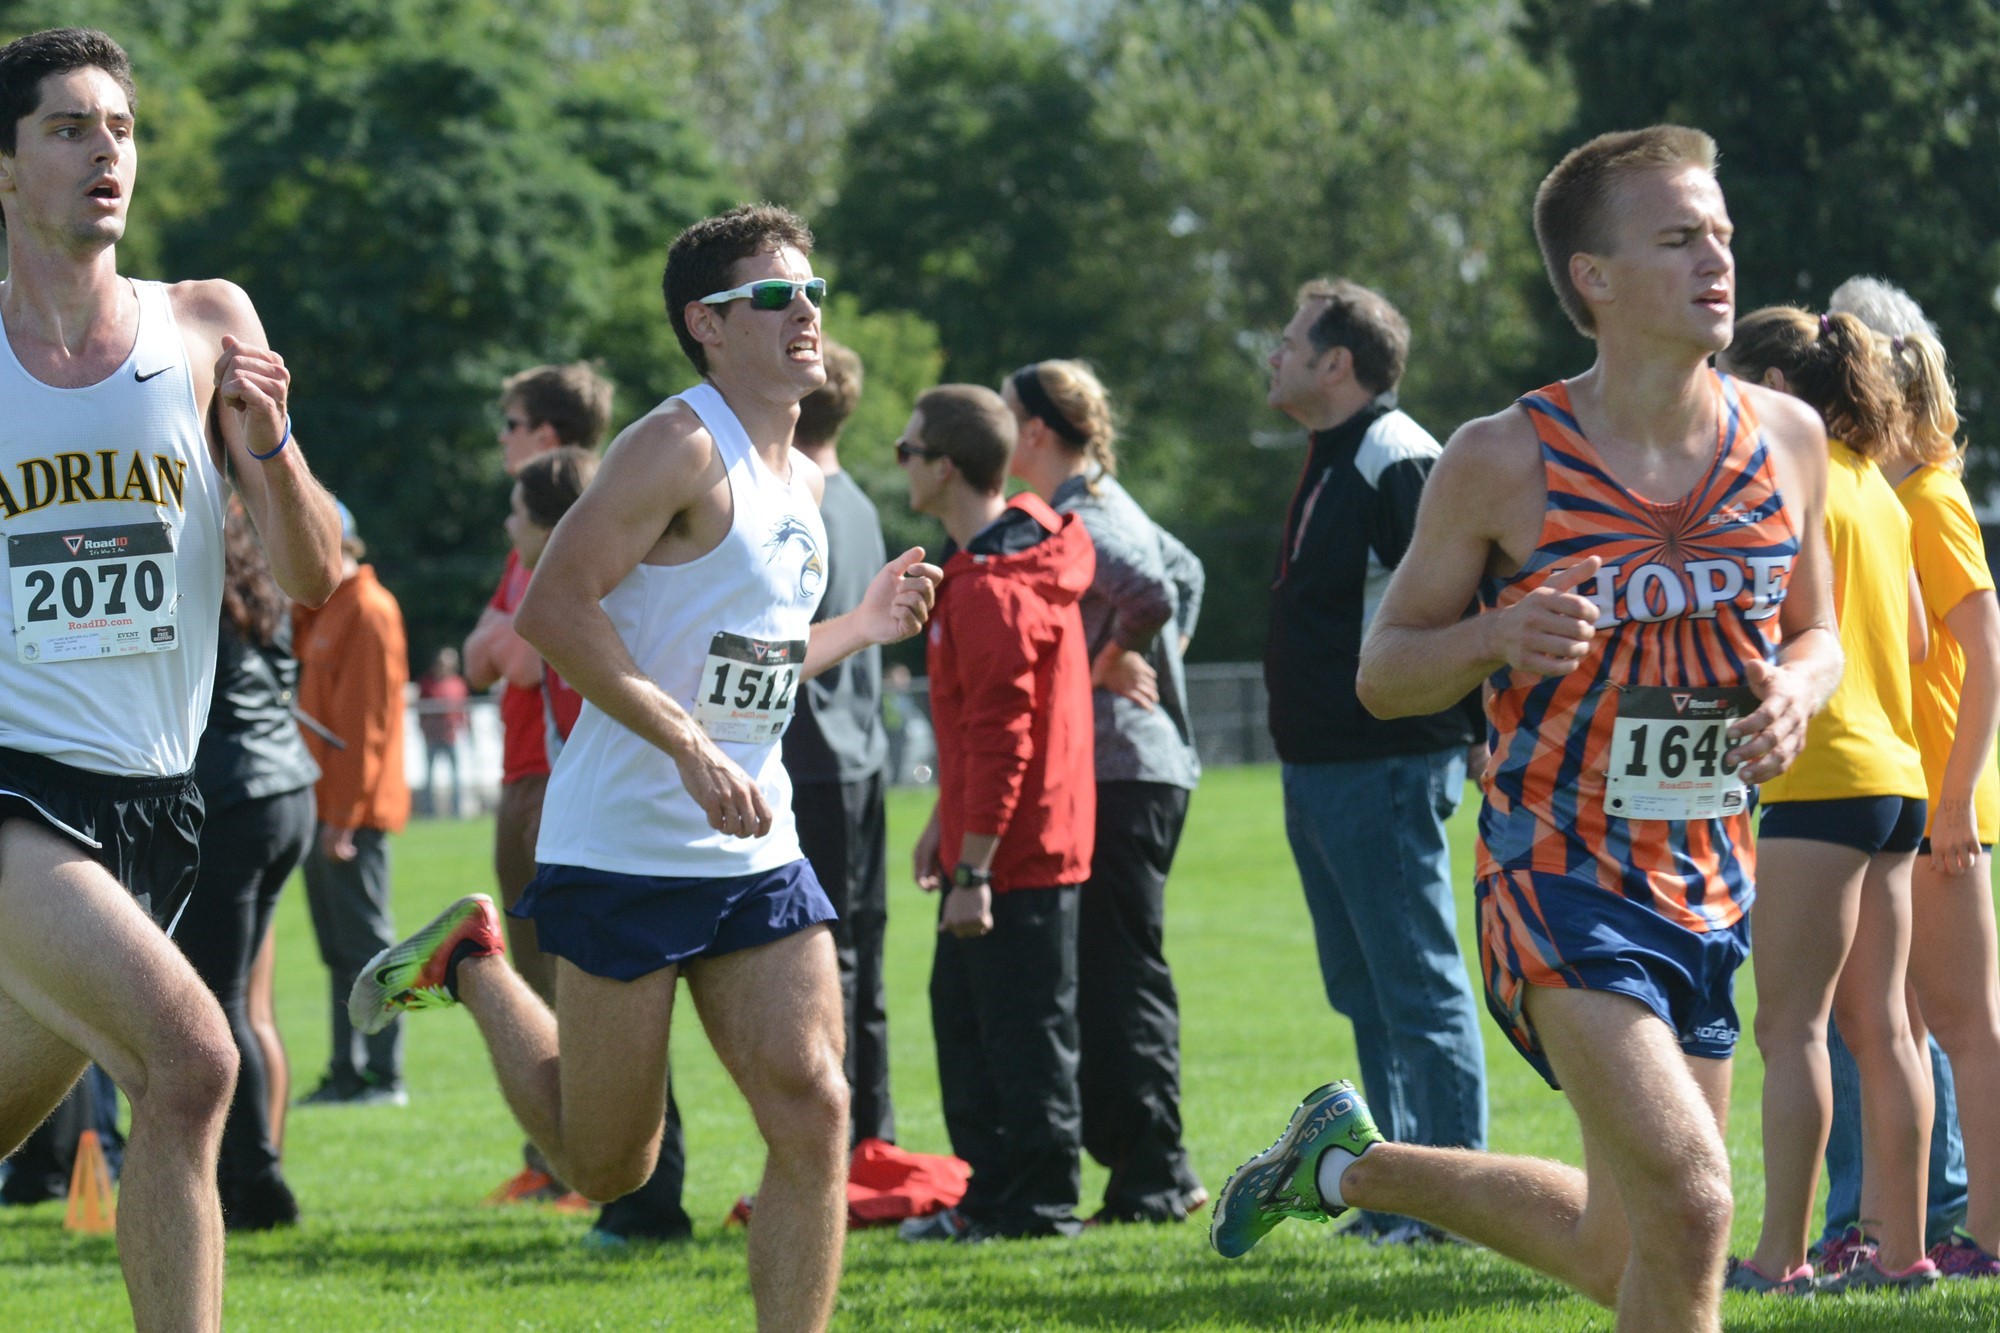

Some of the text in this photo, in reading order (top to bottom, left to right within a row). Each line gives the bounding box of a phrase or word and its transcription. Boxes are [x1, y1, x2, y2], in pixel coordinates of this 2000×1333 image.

[25, 560, 164, 622] 2070
[68, 618, 133, 630] RoadID.com
[708, 663, 793, 710] 1512
